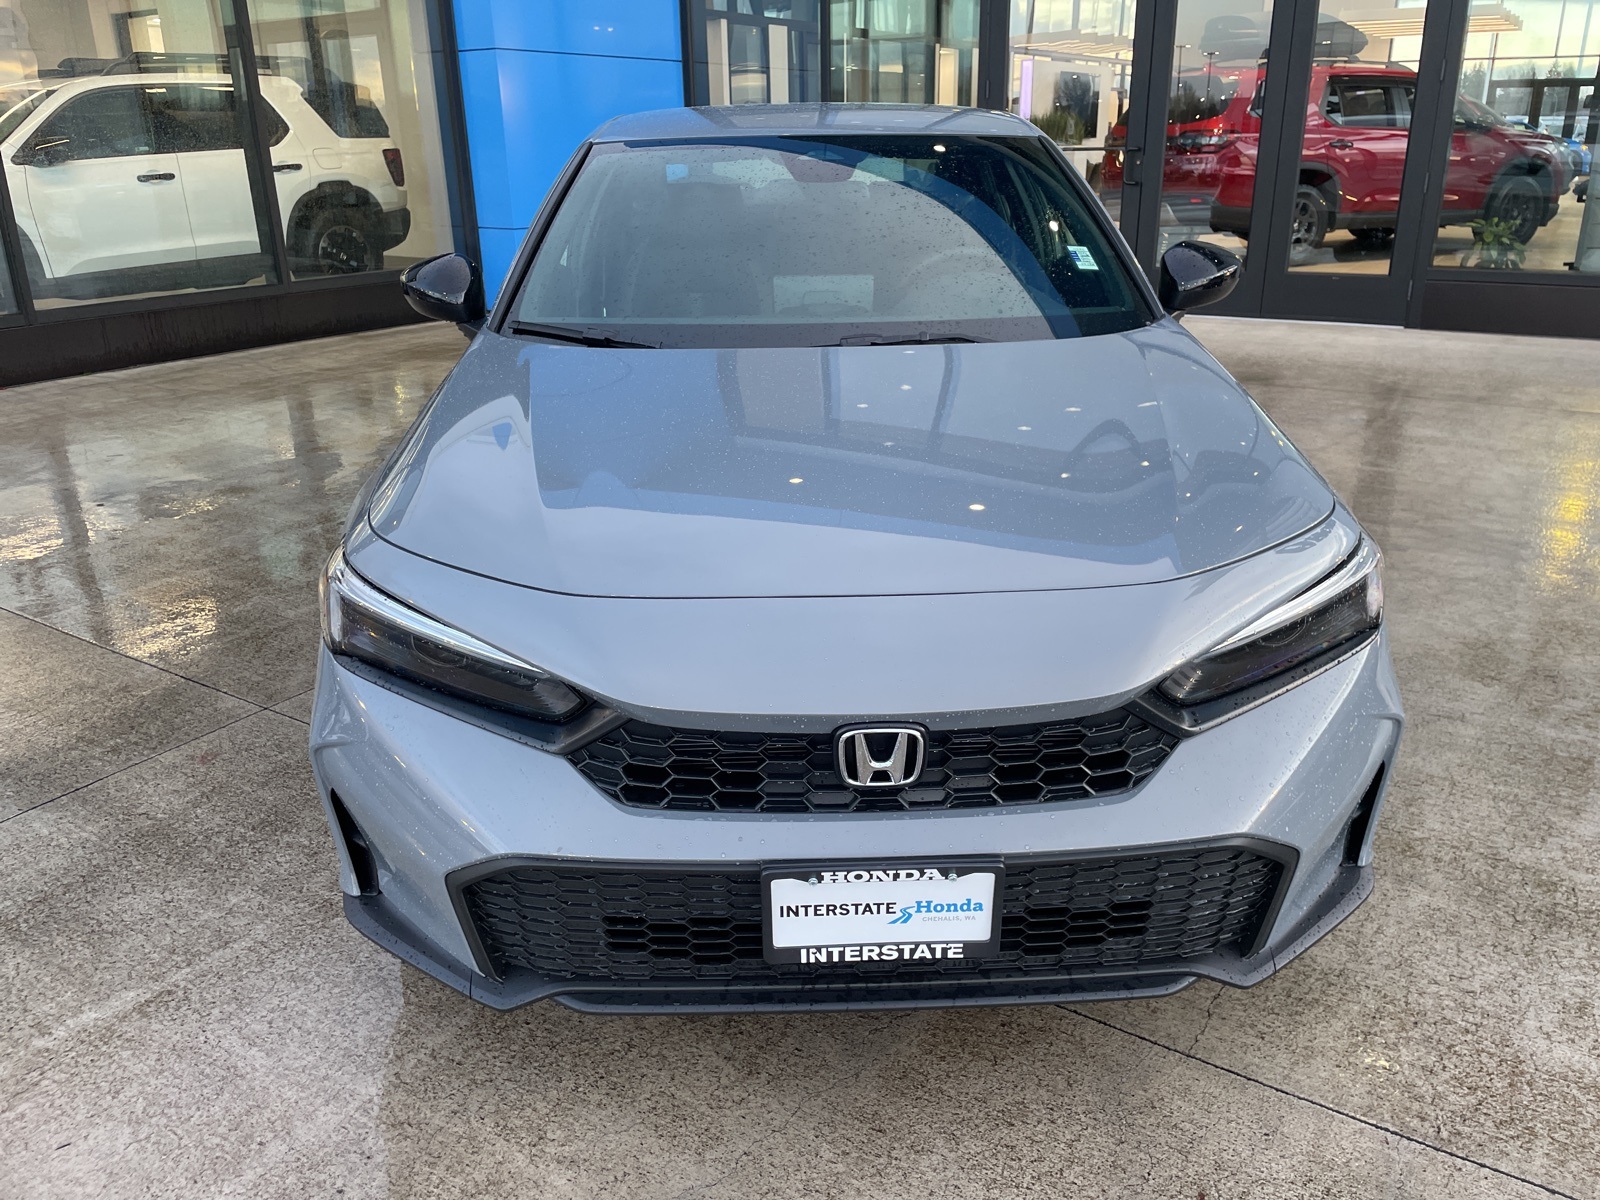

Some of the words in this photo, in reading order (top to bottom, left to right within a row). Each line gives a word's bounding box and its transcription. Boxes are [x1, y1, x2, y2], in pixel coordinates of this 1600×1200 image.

[820, 868, 945, 884] HONDA
[780, 902, 897, 918] INTERSTATE
[914, 898, 984, 914] Honda
[800, 943, 964, 964] INTERSTATE
